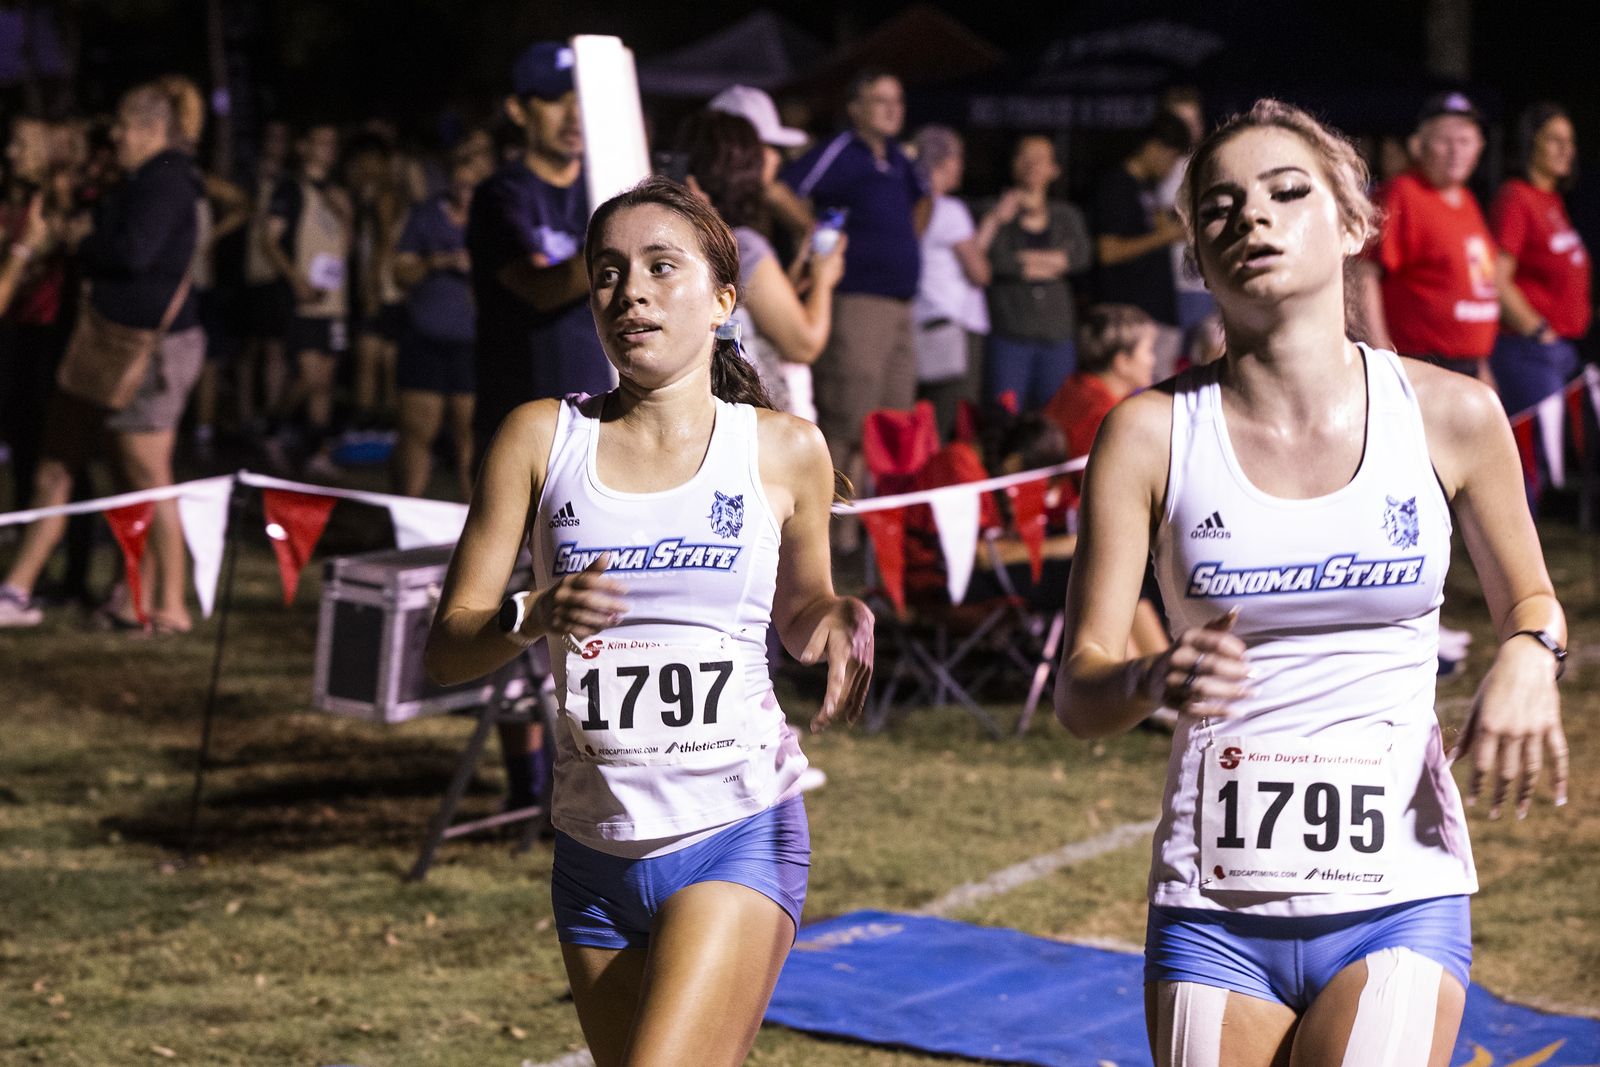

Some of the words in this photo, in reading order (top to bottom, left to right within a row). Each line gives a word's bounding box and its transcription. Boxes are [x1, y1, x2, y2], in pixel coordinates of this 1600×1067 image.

[549, 516, 580, 528] adidas
[1190, 526, 1231, 540] adidas
[553, 542, 648, 576] SONMA
[648, 538, 744, 571] STATE
[1186, 562, 1317, 598] SONOMA
[1316, 553, 1426, 591] STATE
[607, 641, 628, 651] Kim
[580, 660, 733, 731] 1797
[1248, 752, 1270, 762] Kim
[1274, 753, 1309, 765] Duyst
[1312, 754, 1383, 766] Invitational
[1216, 780, 1386, 854] 1795
[1228, 869, 1298, 879] REDCAPTIMING.COM
